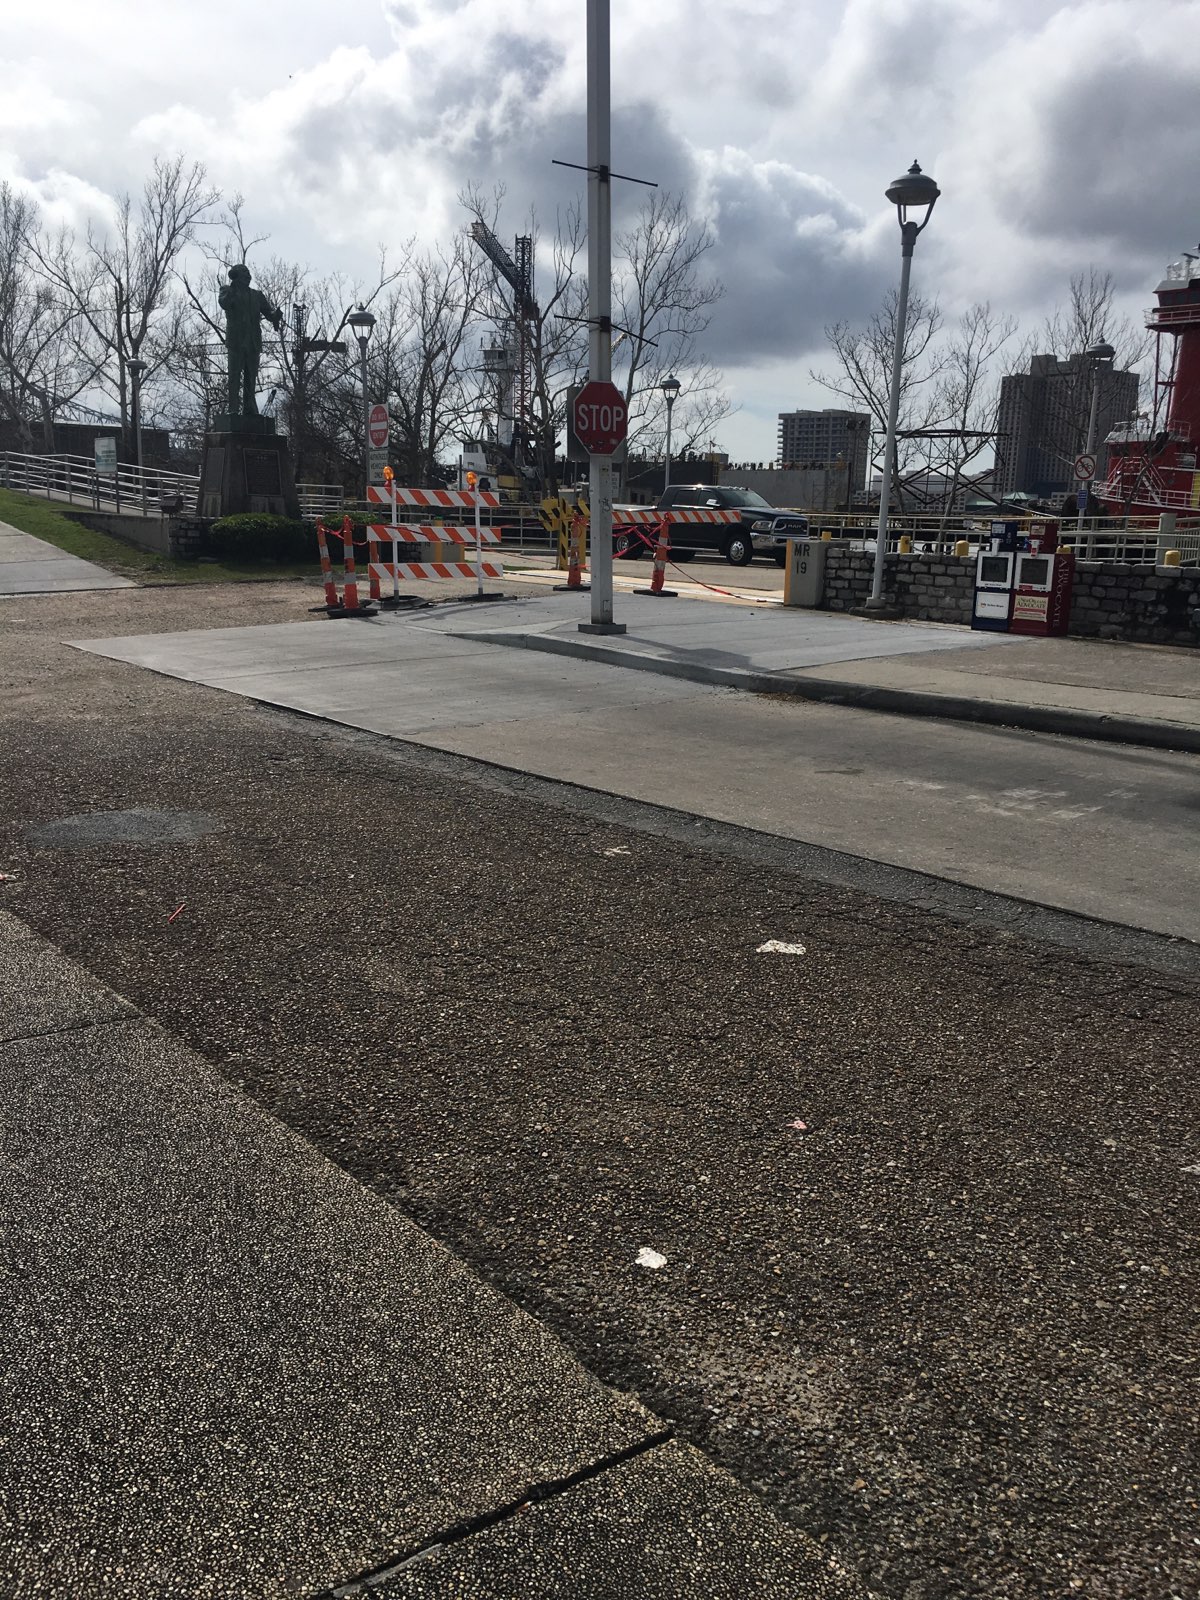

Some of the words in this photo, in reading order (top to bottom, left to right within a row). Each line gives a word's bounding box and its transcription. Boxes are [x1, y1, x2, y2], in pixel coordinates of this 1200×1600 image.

[578, 403, 624, 432] STOP
[372, 431, 385, 439] ENTER
[794, 544, 810, 557] MR
[796, 561, 807, 574] 19
[1053, 557, 1067, 628] ADVOCATE
